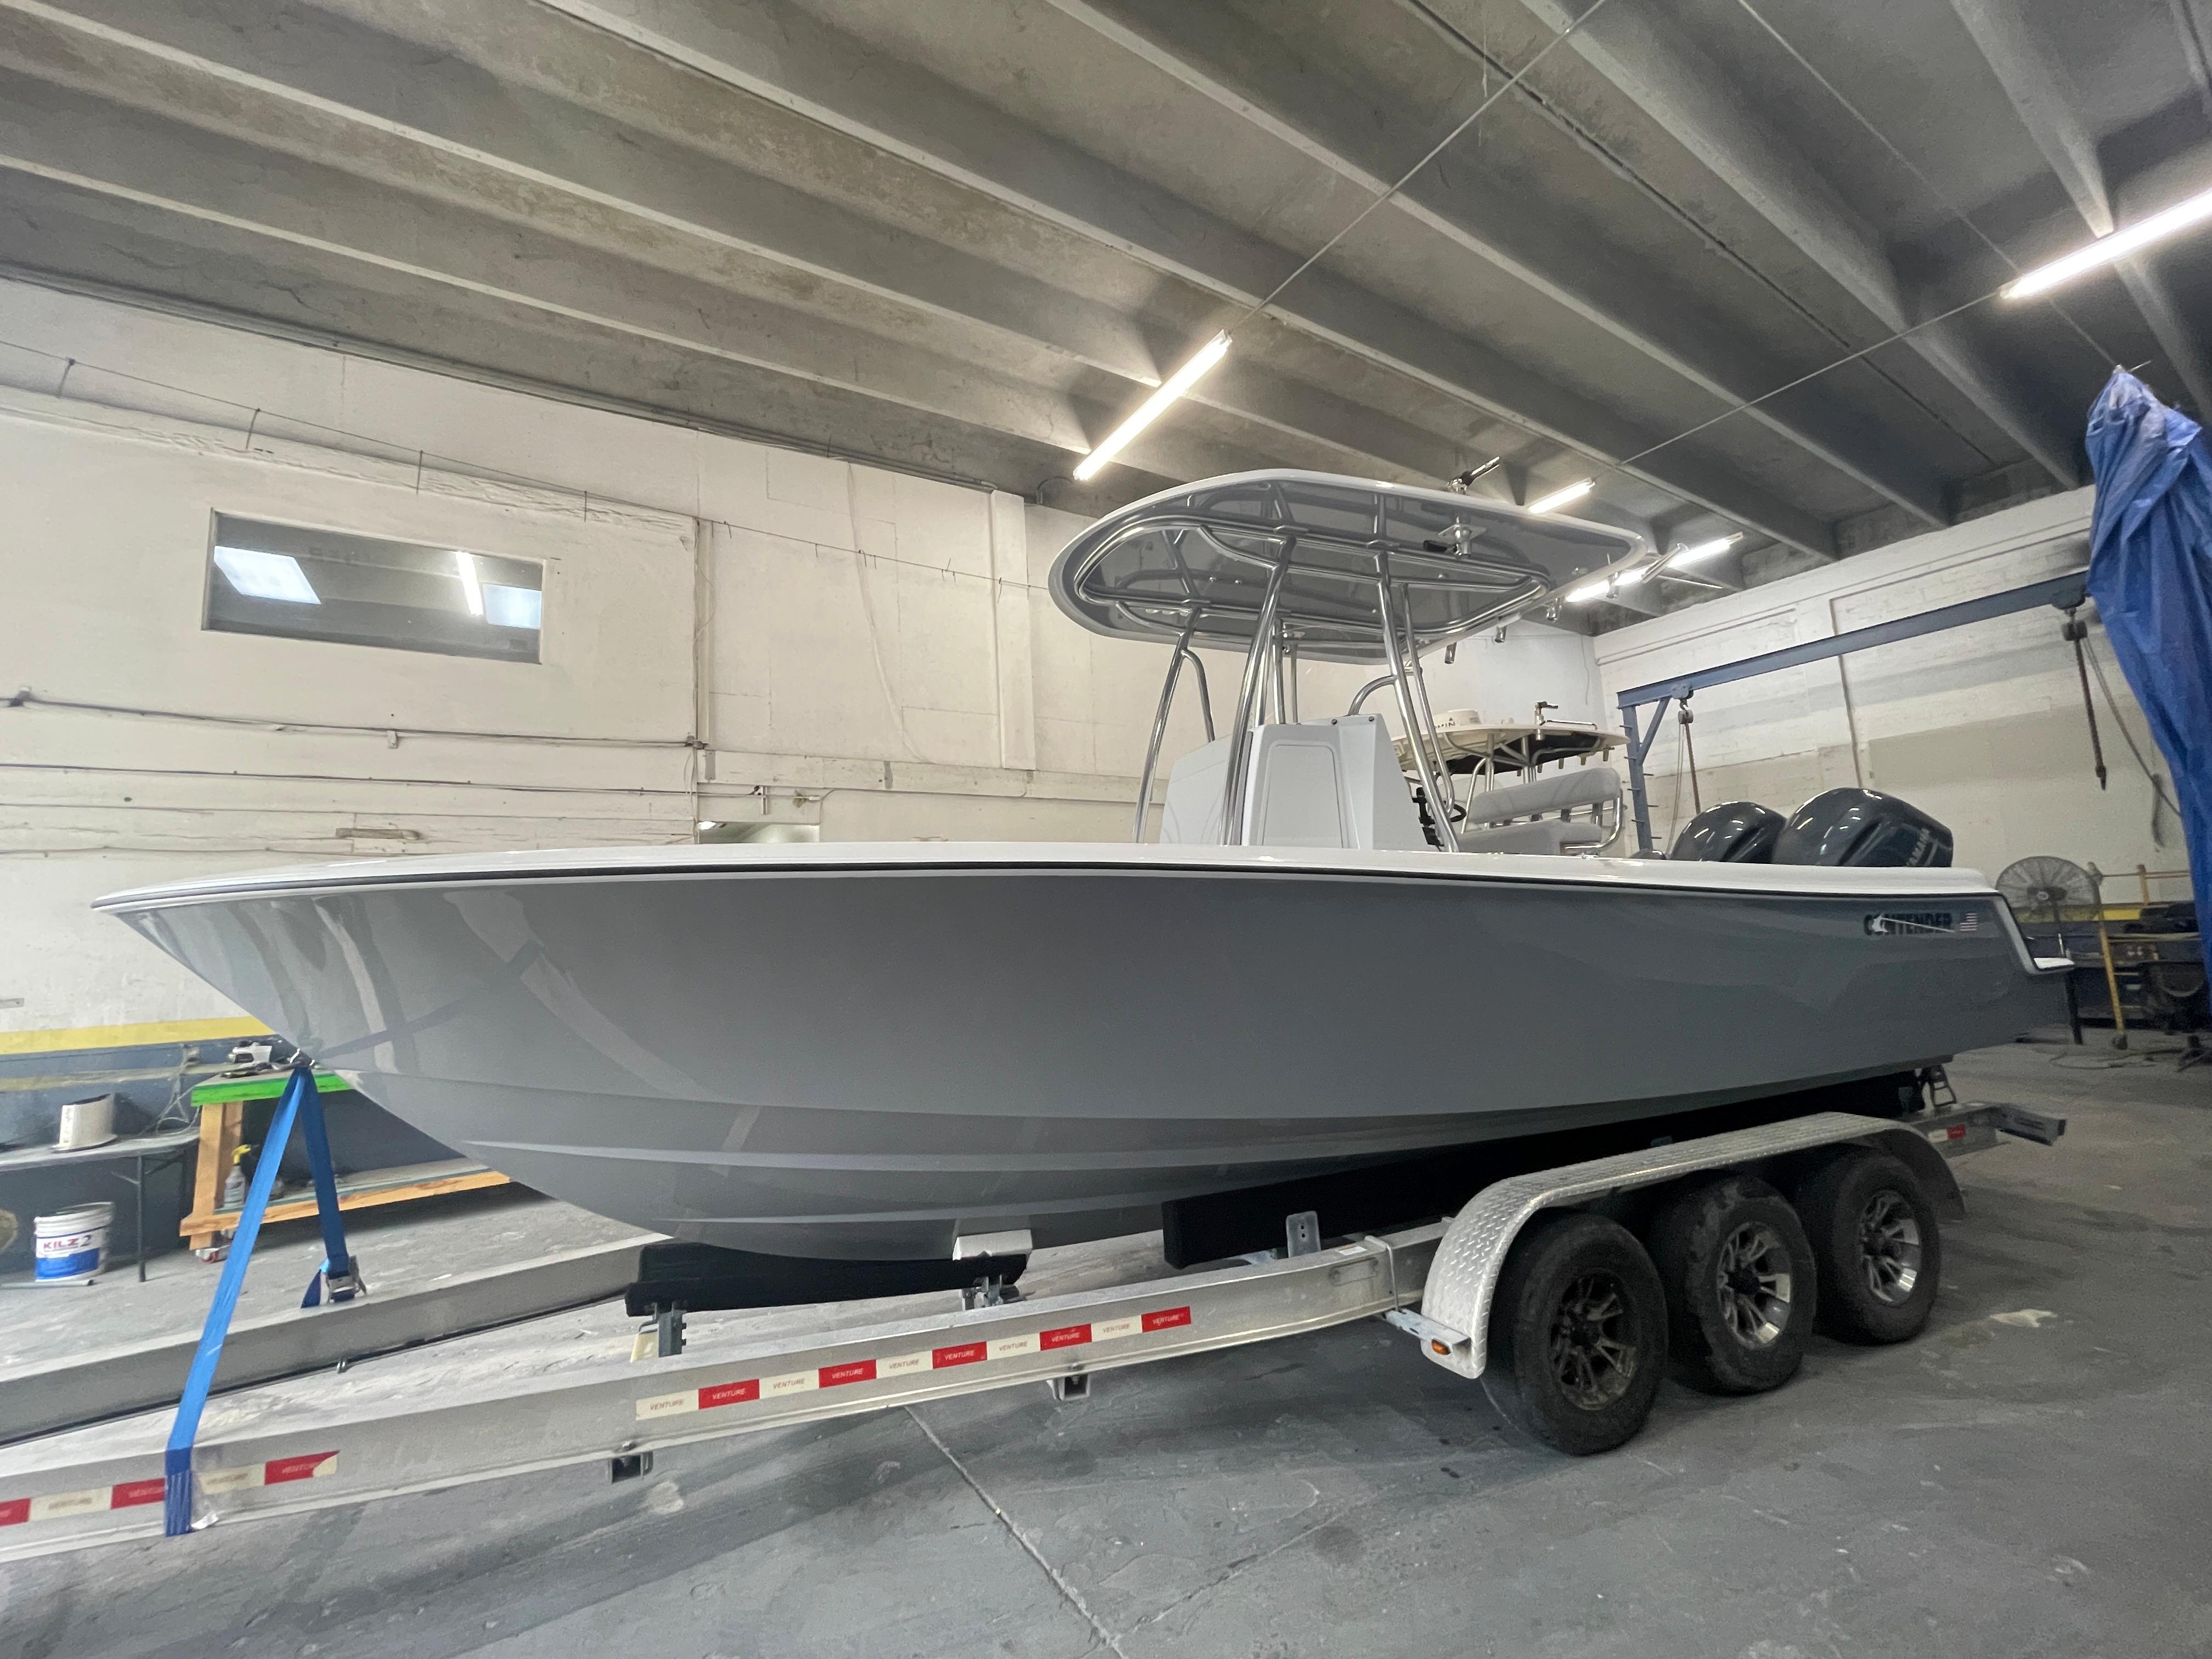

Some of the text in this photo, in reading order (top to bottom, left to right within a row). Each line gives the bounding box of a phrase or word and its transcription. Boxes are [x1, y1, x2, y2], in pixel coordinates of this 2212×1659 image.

[43, 1235, 92, 1249] KILZ 2
[650, 1314, 1180, 1410] VENTURE VENTURE VENTURE VENTURE VENTURE VENTURE VENTURE VENTURE VENTURE VENTURE
